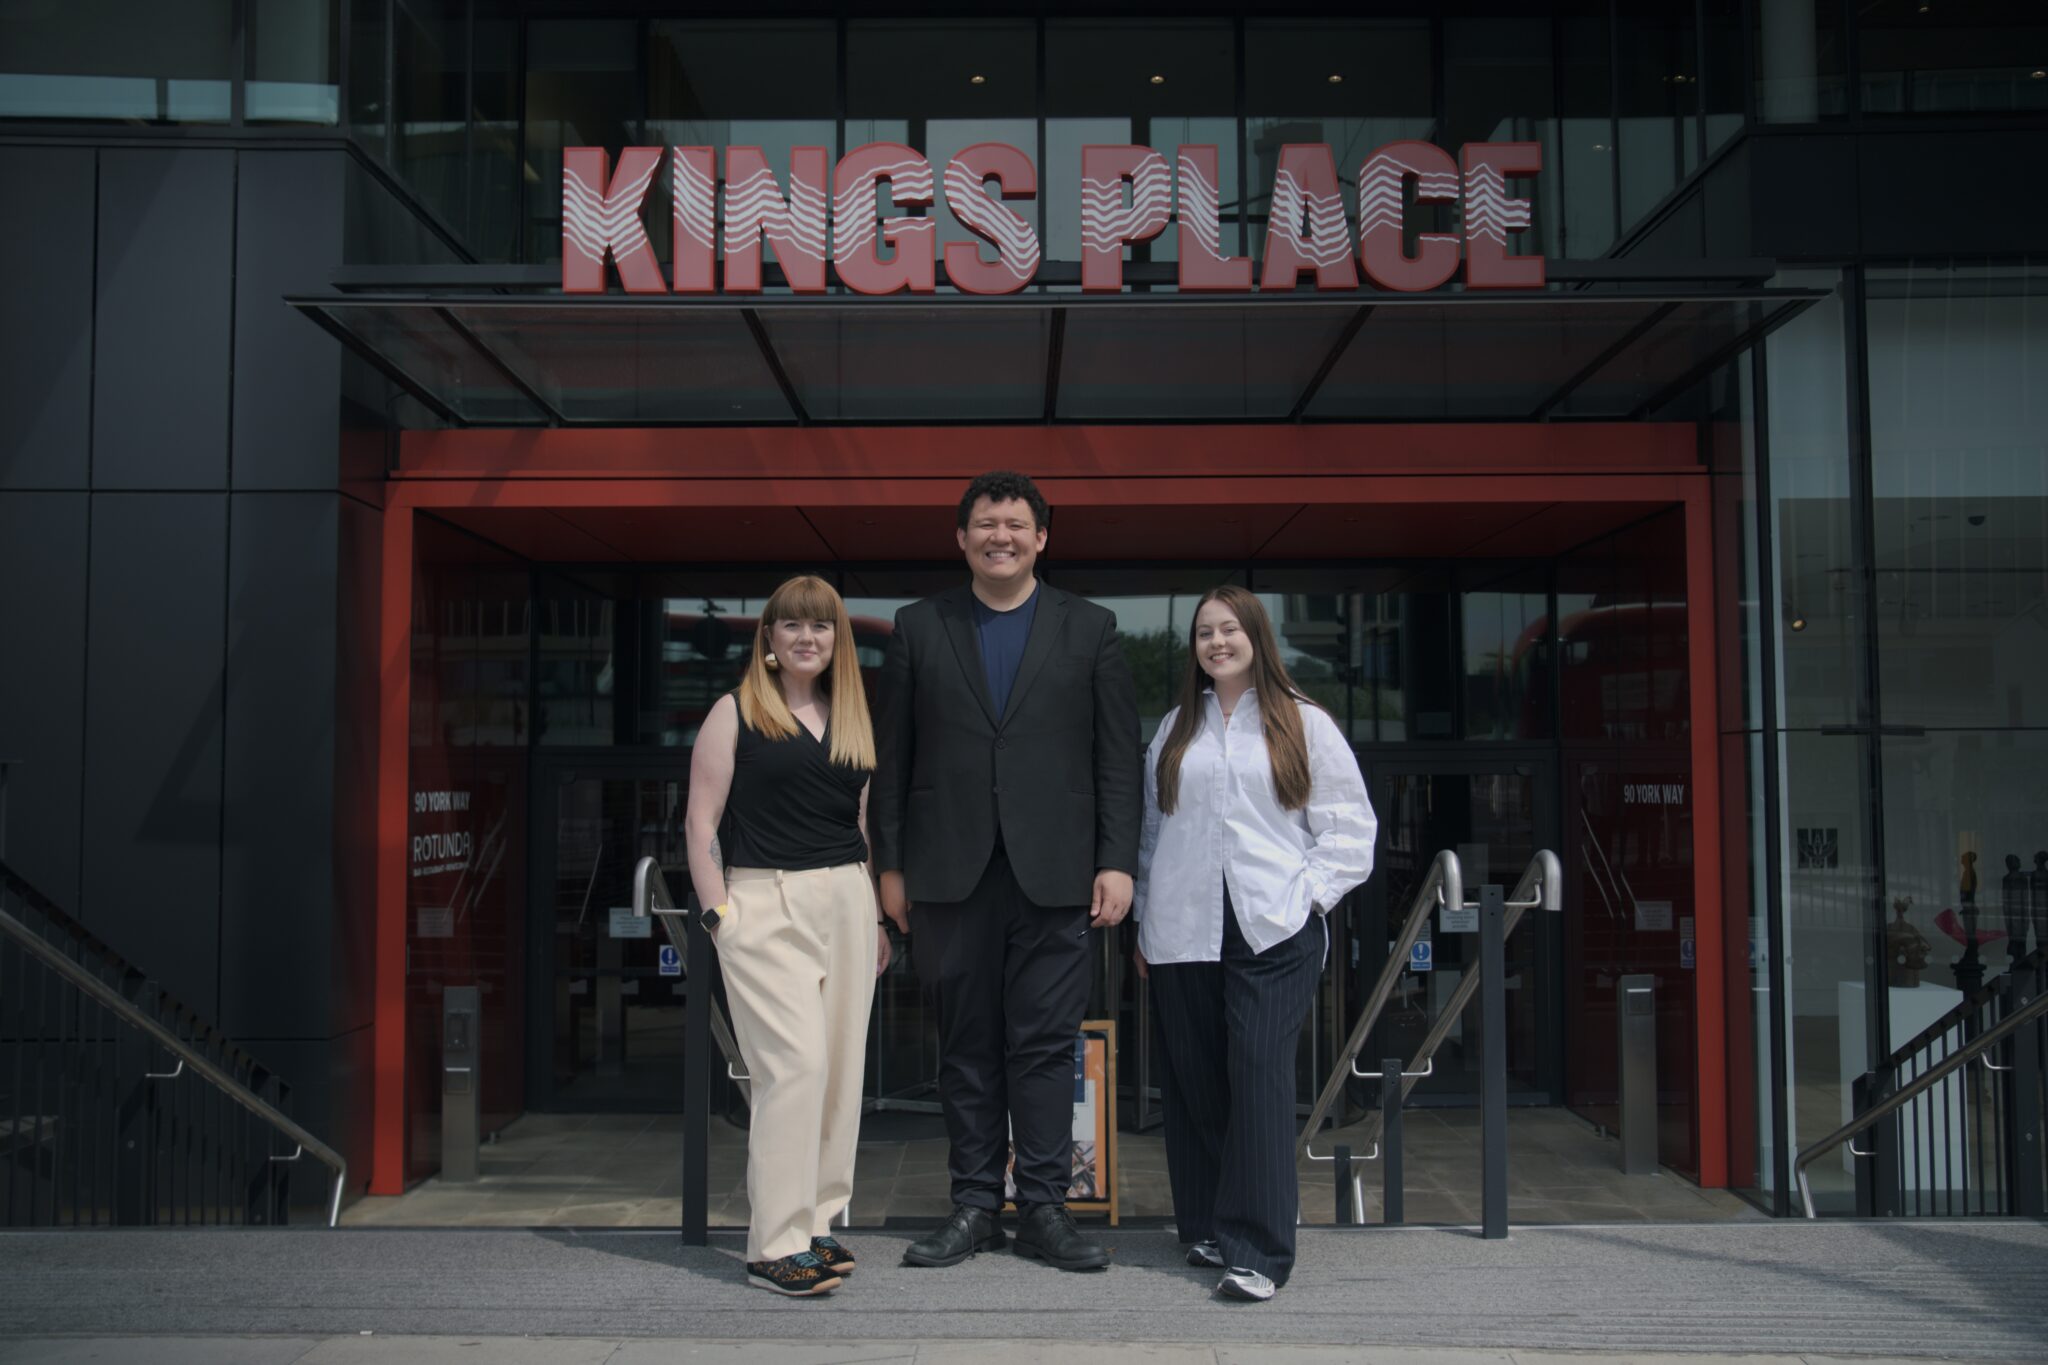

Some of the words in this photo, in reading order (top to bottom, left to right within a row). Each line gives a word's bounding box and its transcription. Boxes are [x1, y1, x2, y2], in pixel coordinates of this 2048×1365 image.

[562, 142, 1039, 295] KINGS
[1081, 141, 1547, 293] PLACE
[415, 792, 427, 812] 90
[428, 791, 451, 812] YORK
[452, 791, 471, 811] WAY
[1624, 784, 1635, 803] 90
[1636, 783, 1661, 804] YORK
[1662, 784, 1684, 804] WAY
[413, 831, 470, 862] ROTUNDA
